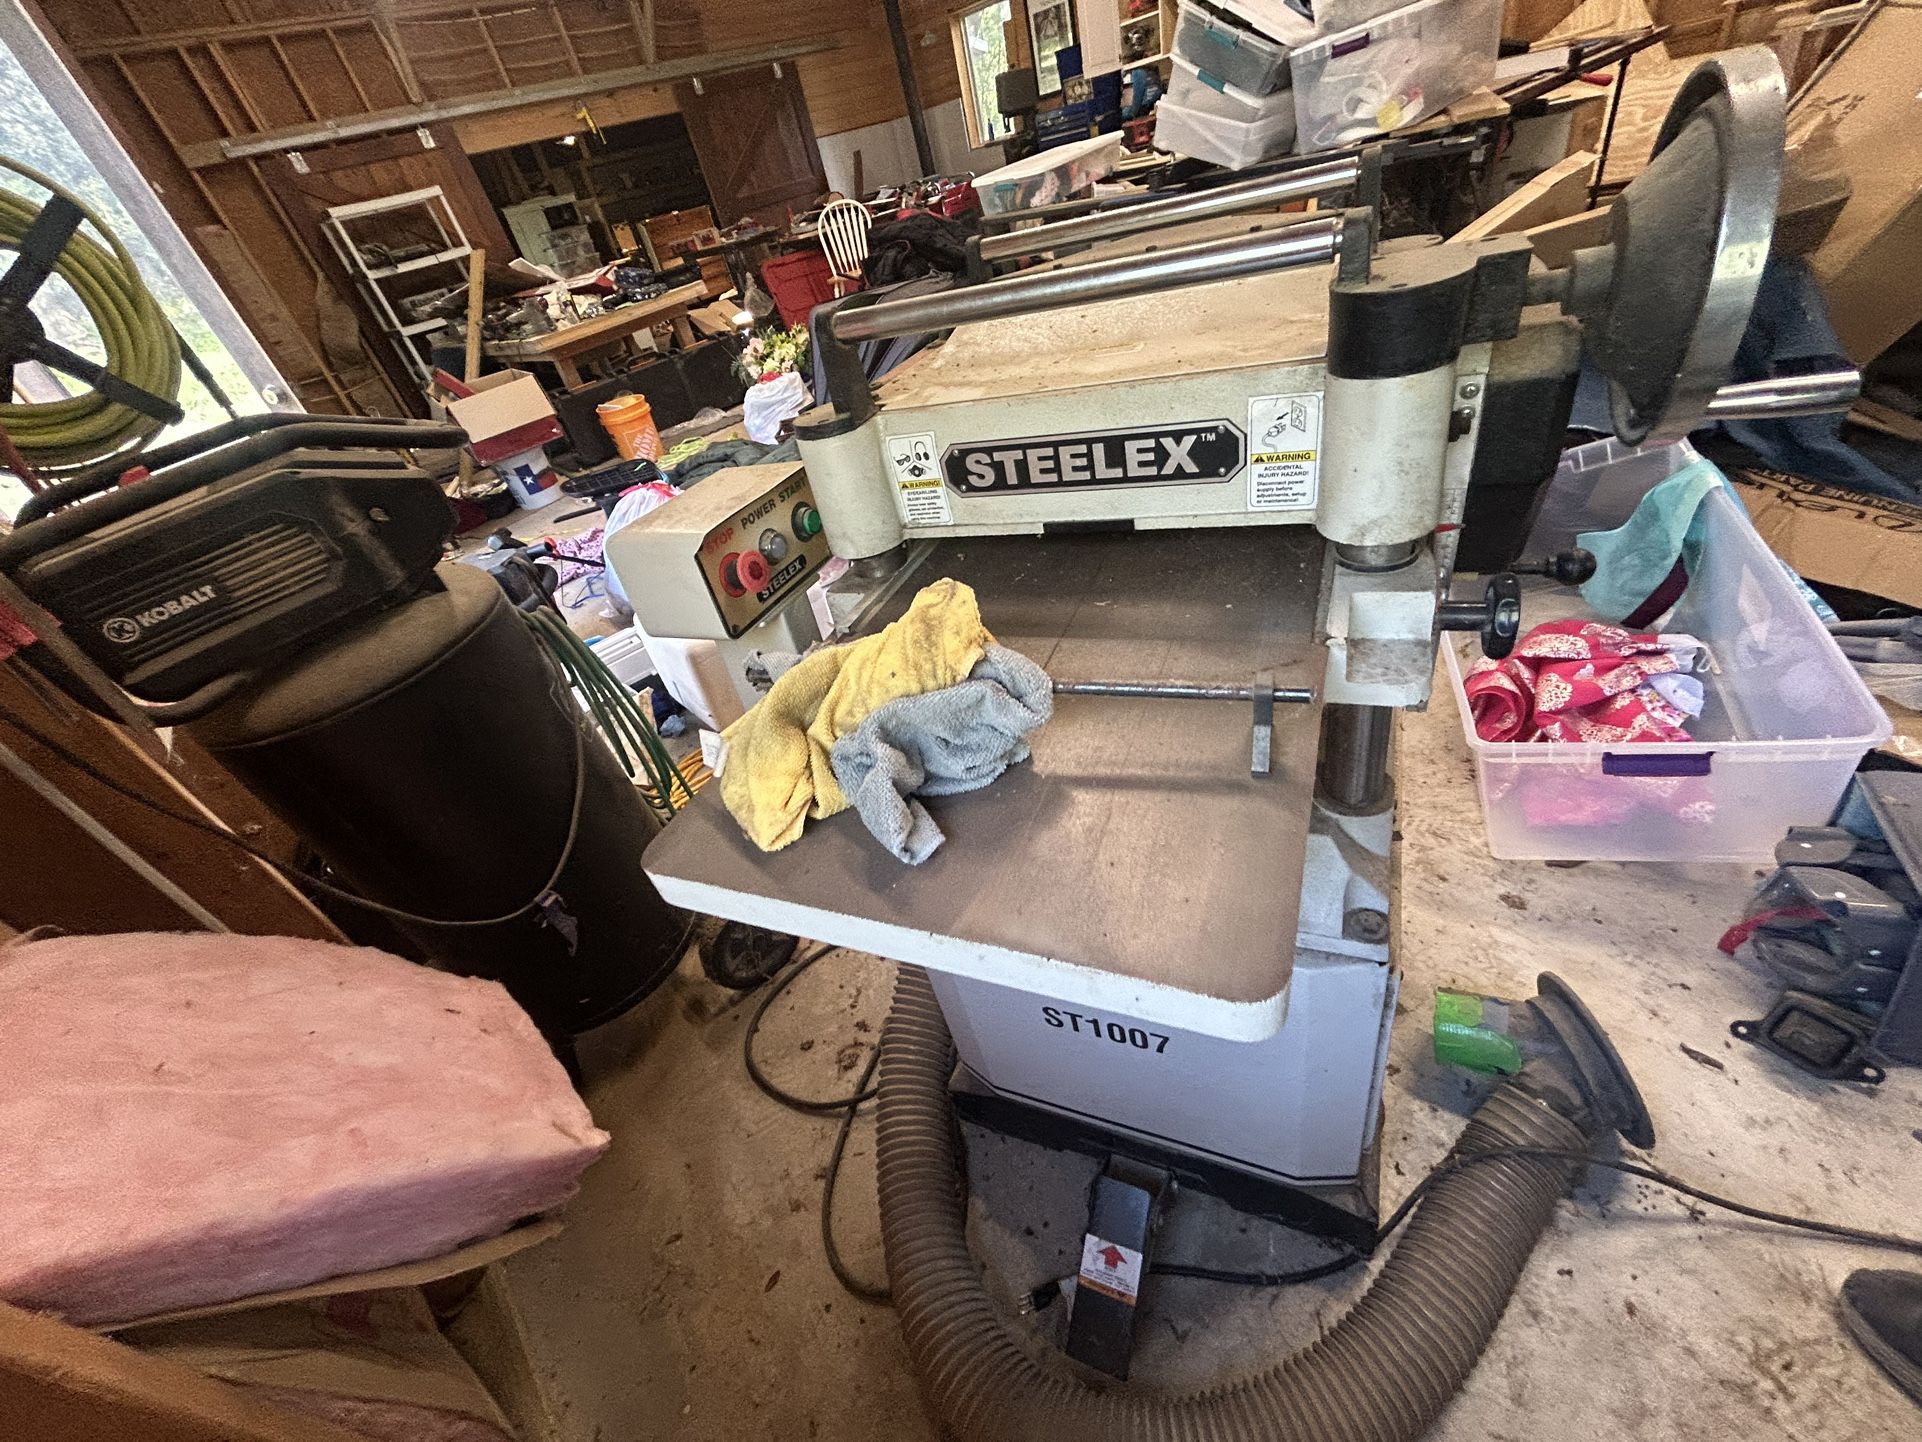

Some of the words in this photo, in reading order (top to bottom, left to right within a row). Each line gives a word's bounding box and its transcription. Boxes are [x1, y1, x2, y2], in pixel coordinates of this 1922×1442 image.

[965, 434, 1200, 488] STEELEX
[1266, 452, 1311, 462] WARNING
[778, 477, 807, 503] START
[740, 499, 777, 530] POWER
[703, 527, 734, 555] STOP
[761, 559, 803, 599] STEELEX
[135, 584, 217, 627] KOBALT
[1042, 1006, 1170, 1054] ST1007
